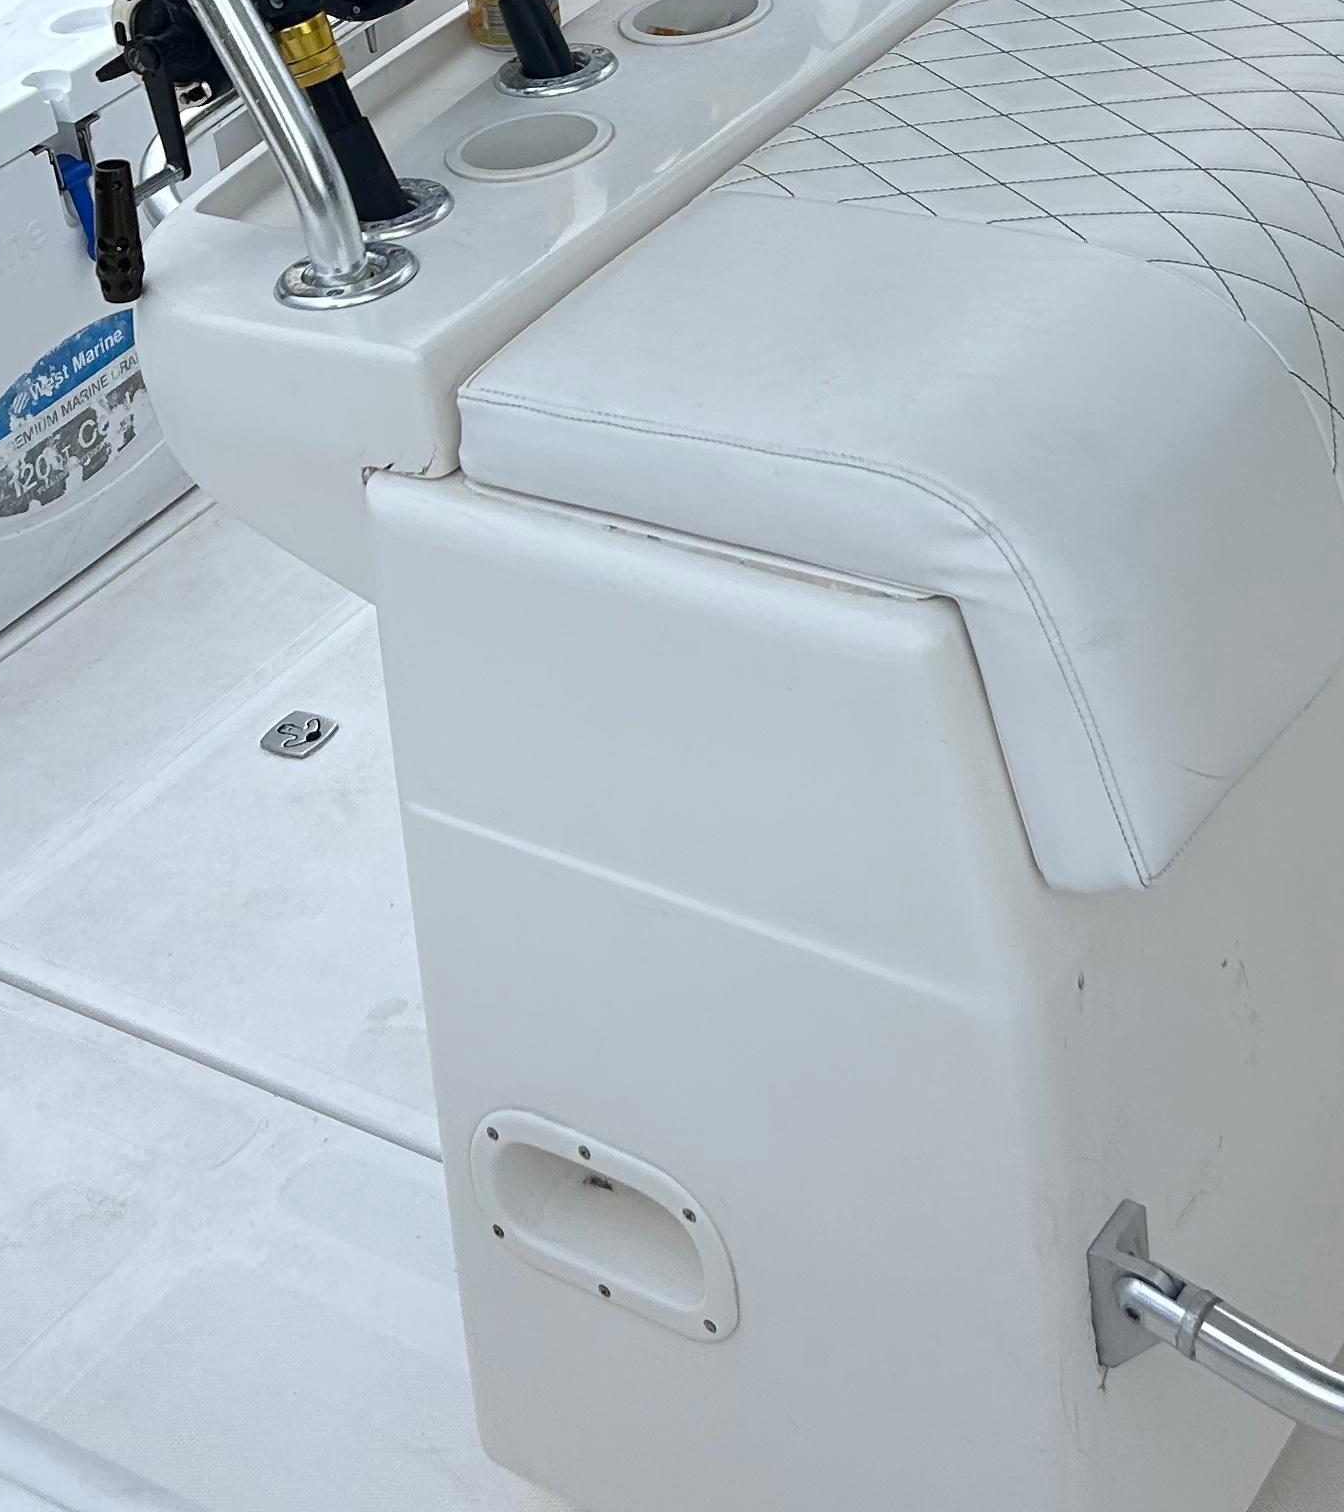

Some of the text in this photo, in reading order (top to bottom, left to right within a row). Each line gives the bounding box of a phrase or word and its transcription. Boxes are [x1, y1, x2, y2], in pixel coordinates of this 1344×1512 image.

[71, 328, 125, 374] Marine
[14, 409, 59, 450] EMIUM
[60, 374, 109, 418] MARINE
